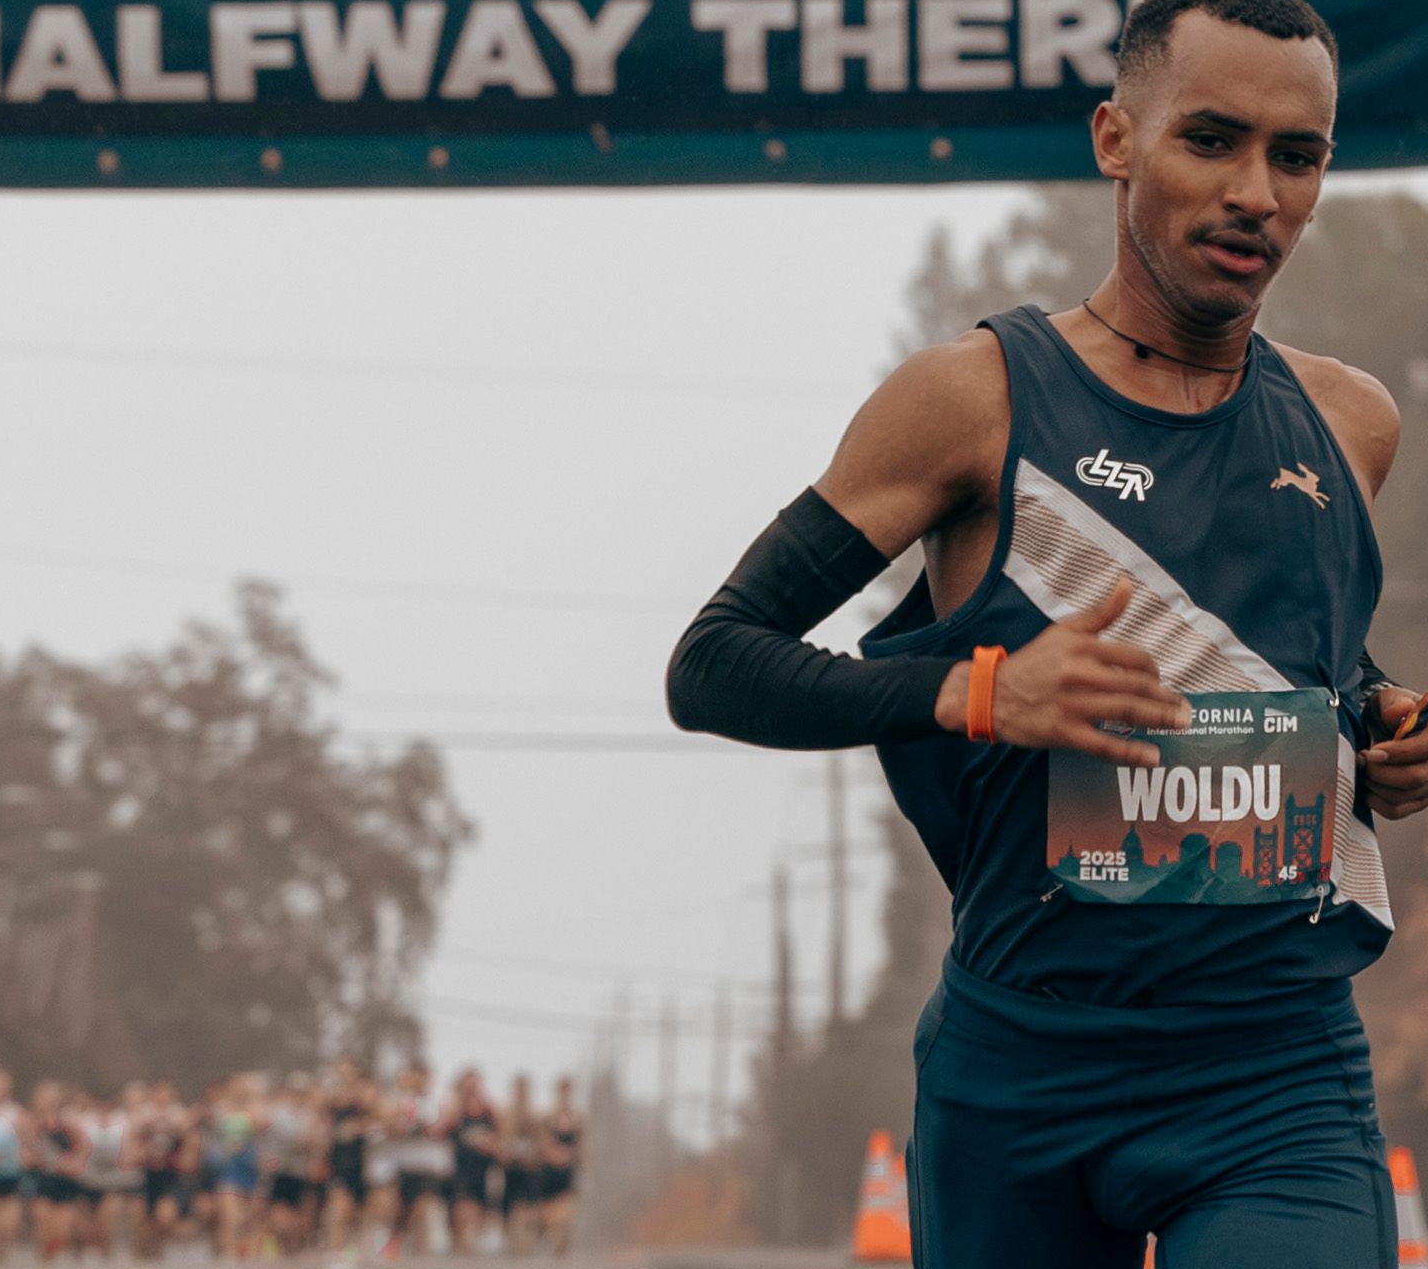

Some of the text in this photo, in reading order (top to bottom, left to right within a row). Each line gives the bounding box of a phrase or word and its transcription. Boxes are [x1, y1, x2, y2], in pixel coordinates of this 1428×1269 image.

[1191, 707, 1255, 724] FORNIA
[1208, 725, 1255, 736] Marathon
[1263, 715, 1298, 733] CIM
[1116, 763, 1282, 823] WOLDU
[1079, 850, 1127, 866] 2025
[1079, 867, 1130, 882] ELITE
[1278, 865, 1298, 880] 45
